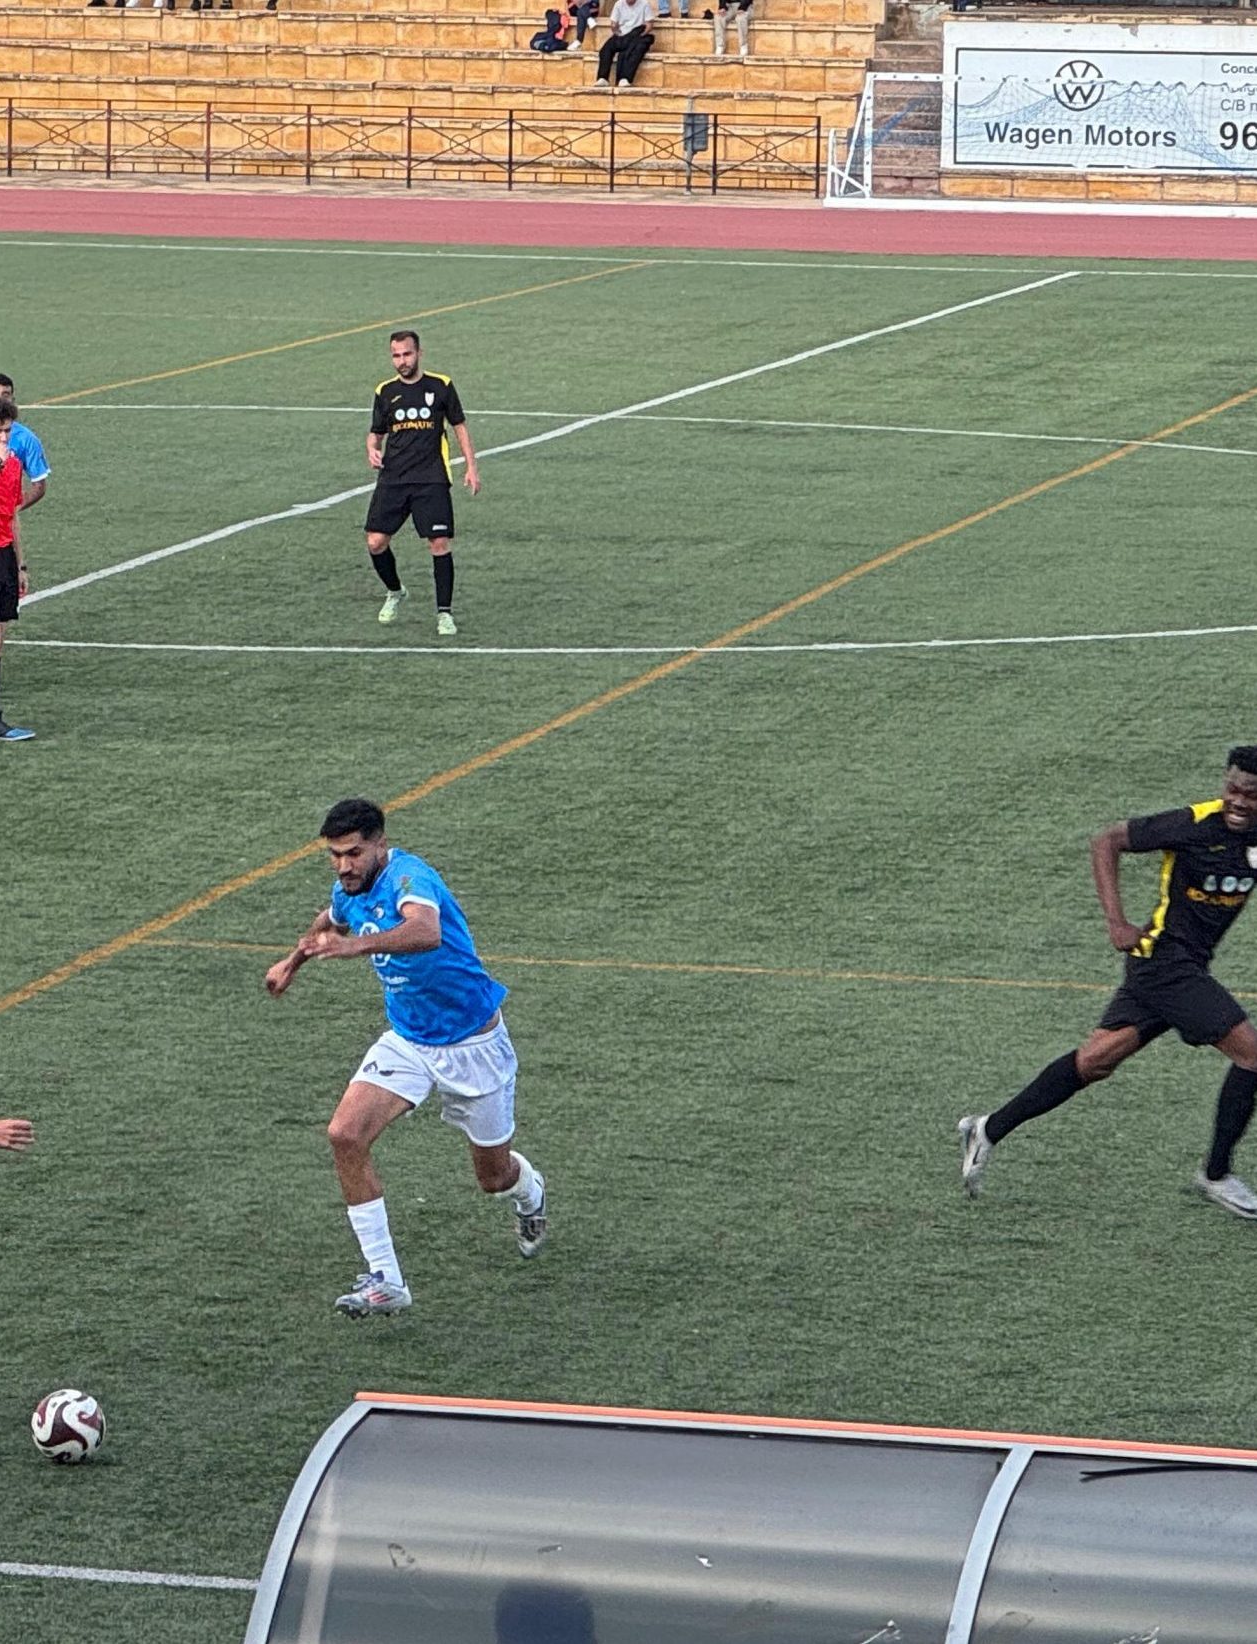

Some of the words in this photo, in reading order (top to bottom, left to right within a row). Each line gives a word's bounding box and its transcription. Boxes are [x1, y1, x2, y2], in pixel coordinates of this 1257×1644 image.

[1220, 99, 1246, 111] C/B
[984, 122, 1073, 150] Wagen
[1084, 124, 1177, 148] Motors
[1219, 121, 1257, 151] 96
